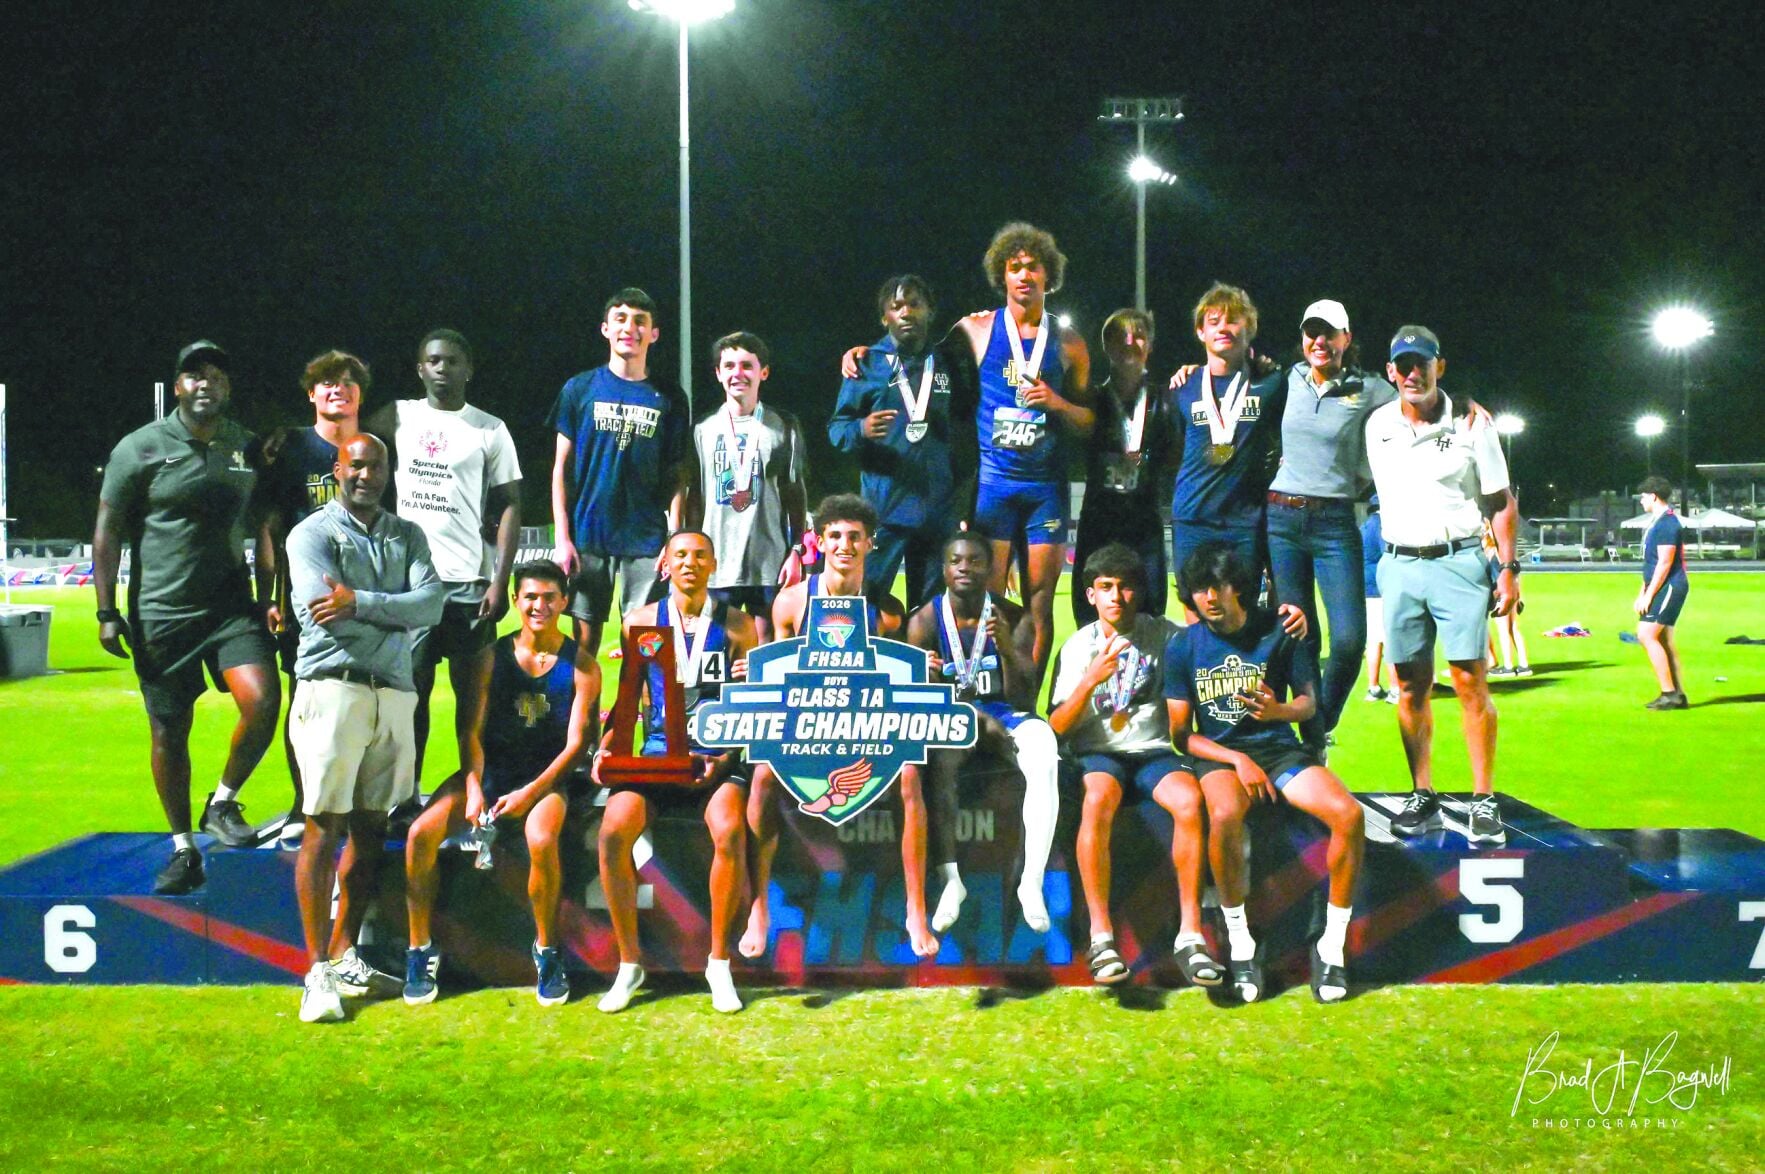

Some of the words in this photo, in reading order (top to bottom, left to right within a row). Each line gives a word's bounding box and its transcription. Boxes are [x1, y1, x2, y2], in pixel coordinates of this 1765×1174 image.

[595, 419, 622, 432] TRAC
[1000, 421, 1037, 446] 346
[412, 458, 448, 470] Special
[408, 467, 453, 479] Olympics
[419, 478, 441, 486] Florida
[412, 490, 423, 500] I'm
[424, 493, 430, 501] A
[431, 494, 449, 503] Fan.
[412, 502, 419, 510] A
[420, 502, 461, 515] Volunteer.
[821, 600, 851, 609] 2026
[807, 651, 864, 668] FHSAA
[704, 653, 722, 680] 4
[1196, 668, 1207, 677] 20
[823, 676, 848, 686] BOYS
[1197, 676, 1262, 702] CHAMPIO
[786, 688, 851, 708] CLASS
[860, 688, 884, 708] 1A
[703, 712, 787, 741] STATE
[795, 712, 970, 742] CHAMPIONS
[781, 743, 832, 755] TRACK
[835, 743, 848, 755] &
[851, 743, 894, 755] FIELD
[837, 809, 995, 843] CHAON
[1459, 859, 1524, 943] 5
[44, 905, 97, 972] 6
